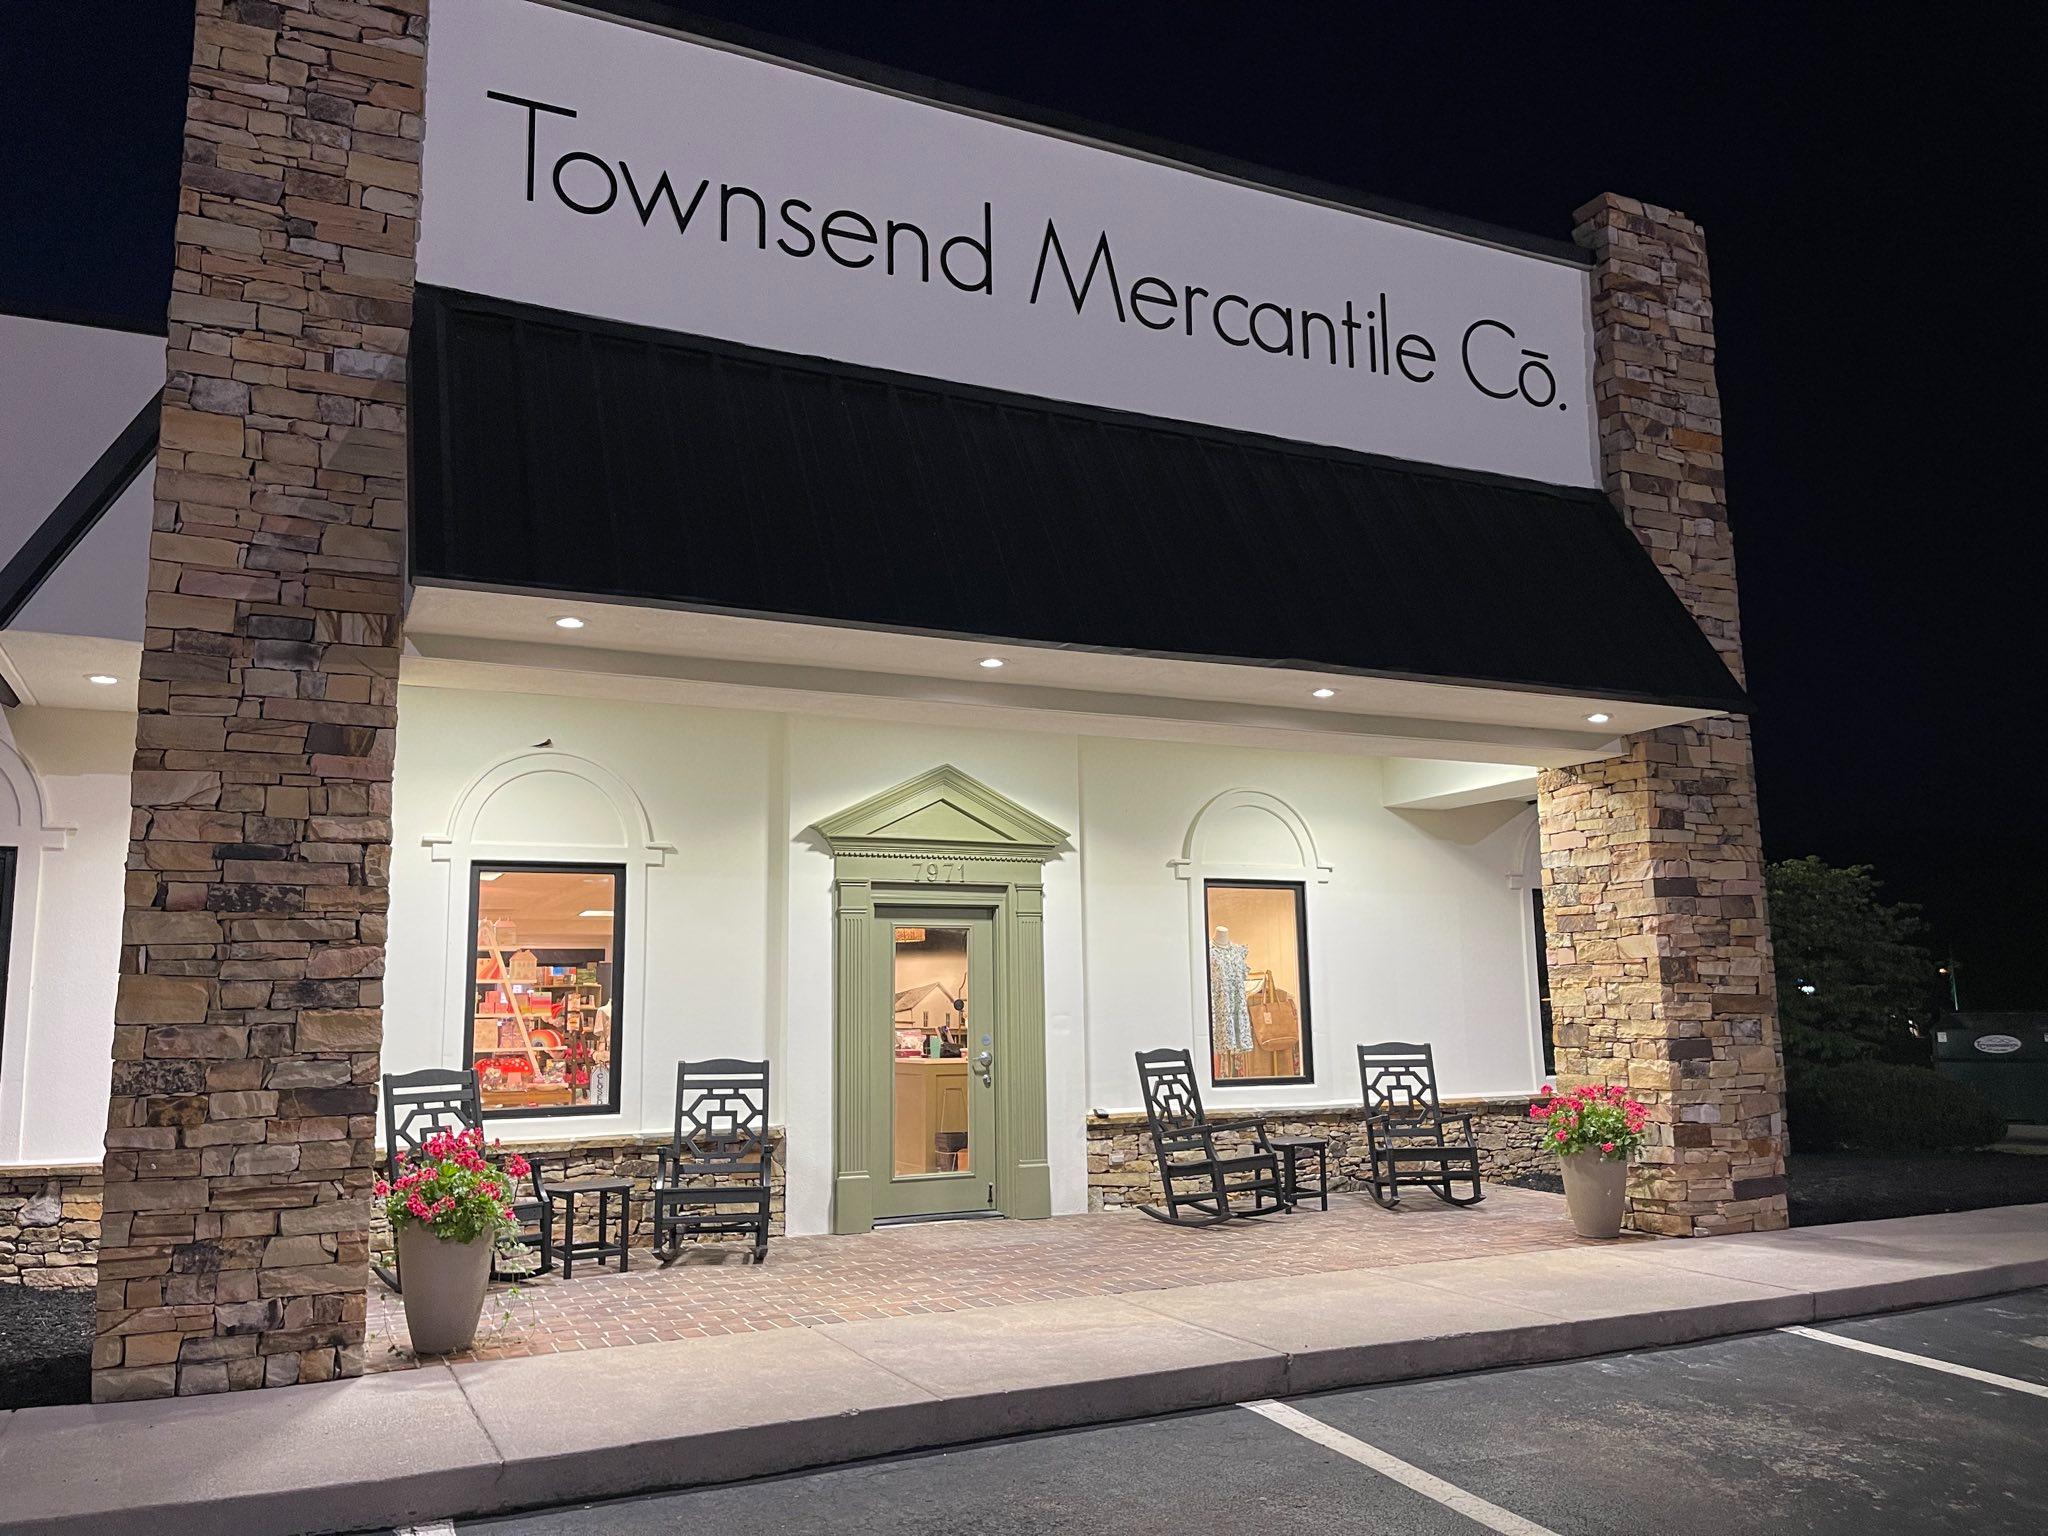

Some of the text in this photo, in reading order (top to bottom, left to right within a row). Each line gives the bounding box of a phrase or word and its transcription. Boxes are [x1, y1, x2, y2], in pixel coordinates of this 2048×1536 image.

[487, 90, 993, 296] Townsend
[1029, 217, 1437, 383] Mercantile
[912, 863, 966, 883] 7971
